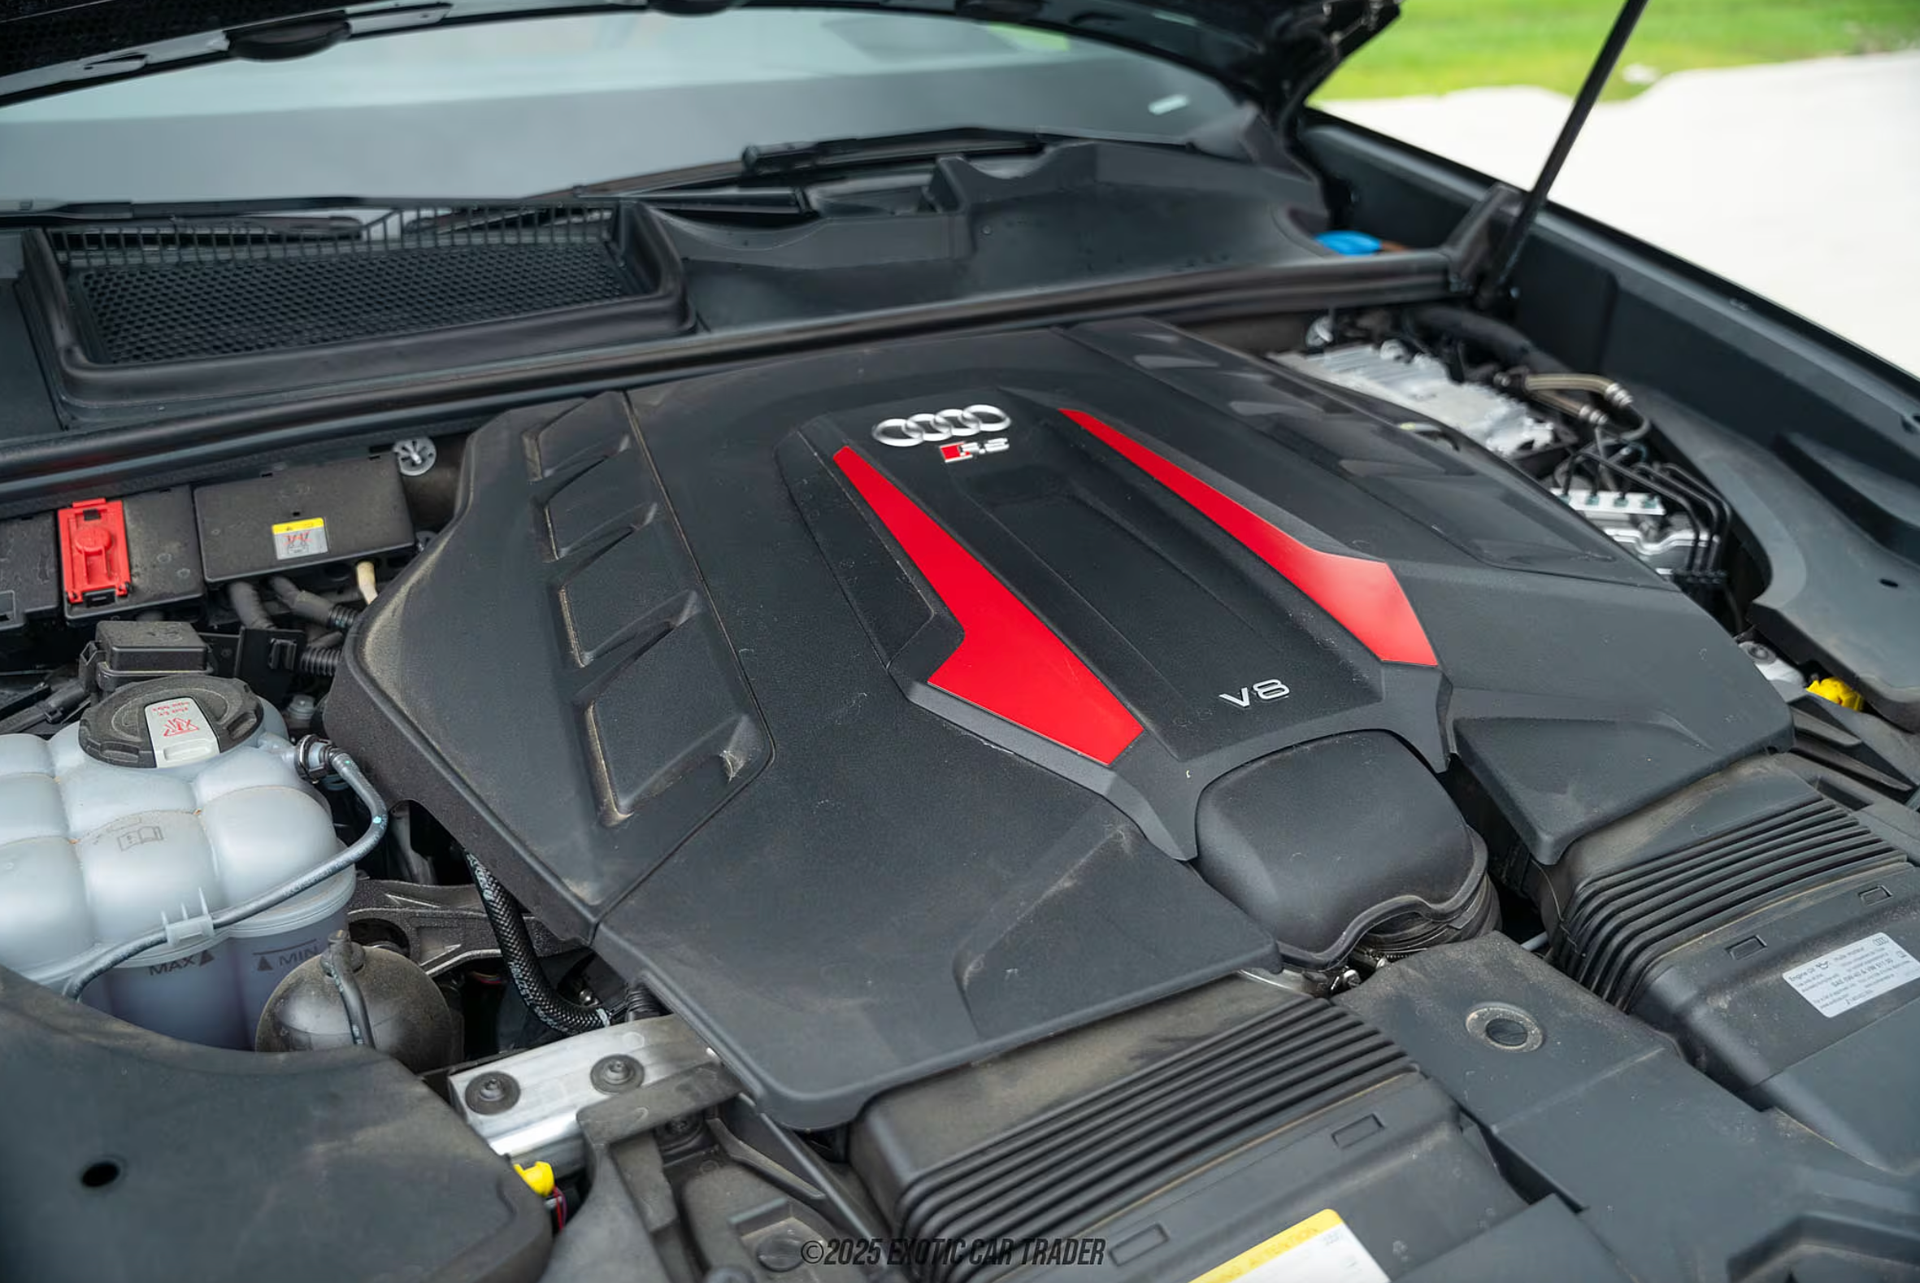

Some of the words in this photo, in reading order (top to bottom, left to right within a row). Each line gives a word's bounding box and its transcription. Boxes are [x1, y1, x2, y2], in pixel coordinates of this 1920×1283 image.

[1219, 679, 1290, 707] V8
[150, 957, 195, 976] MAX
[279, 946, 319, 967] MIN
